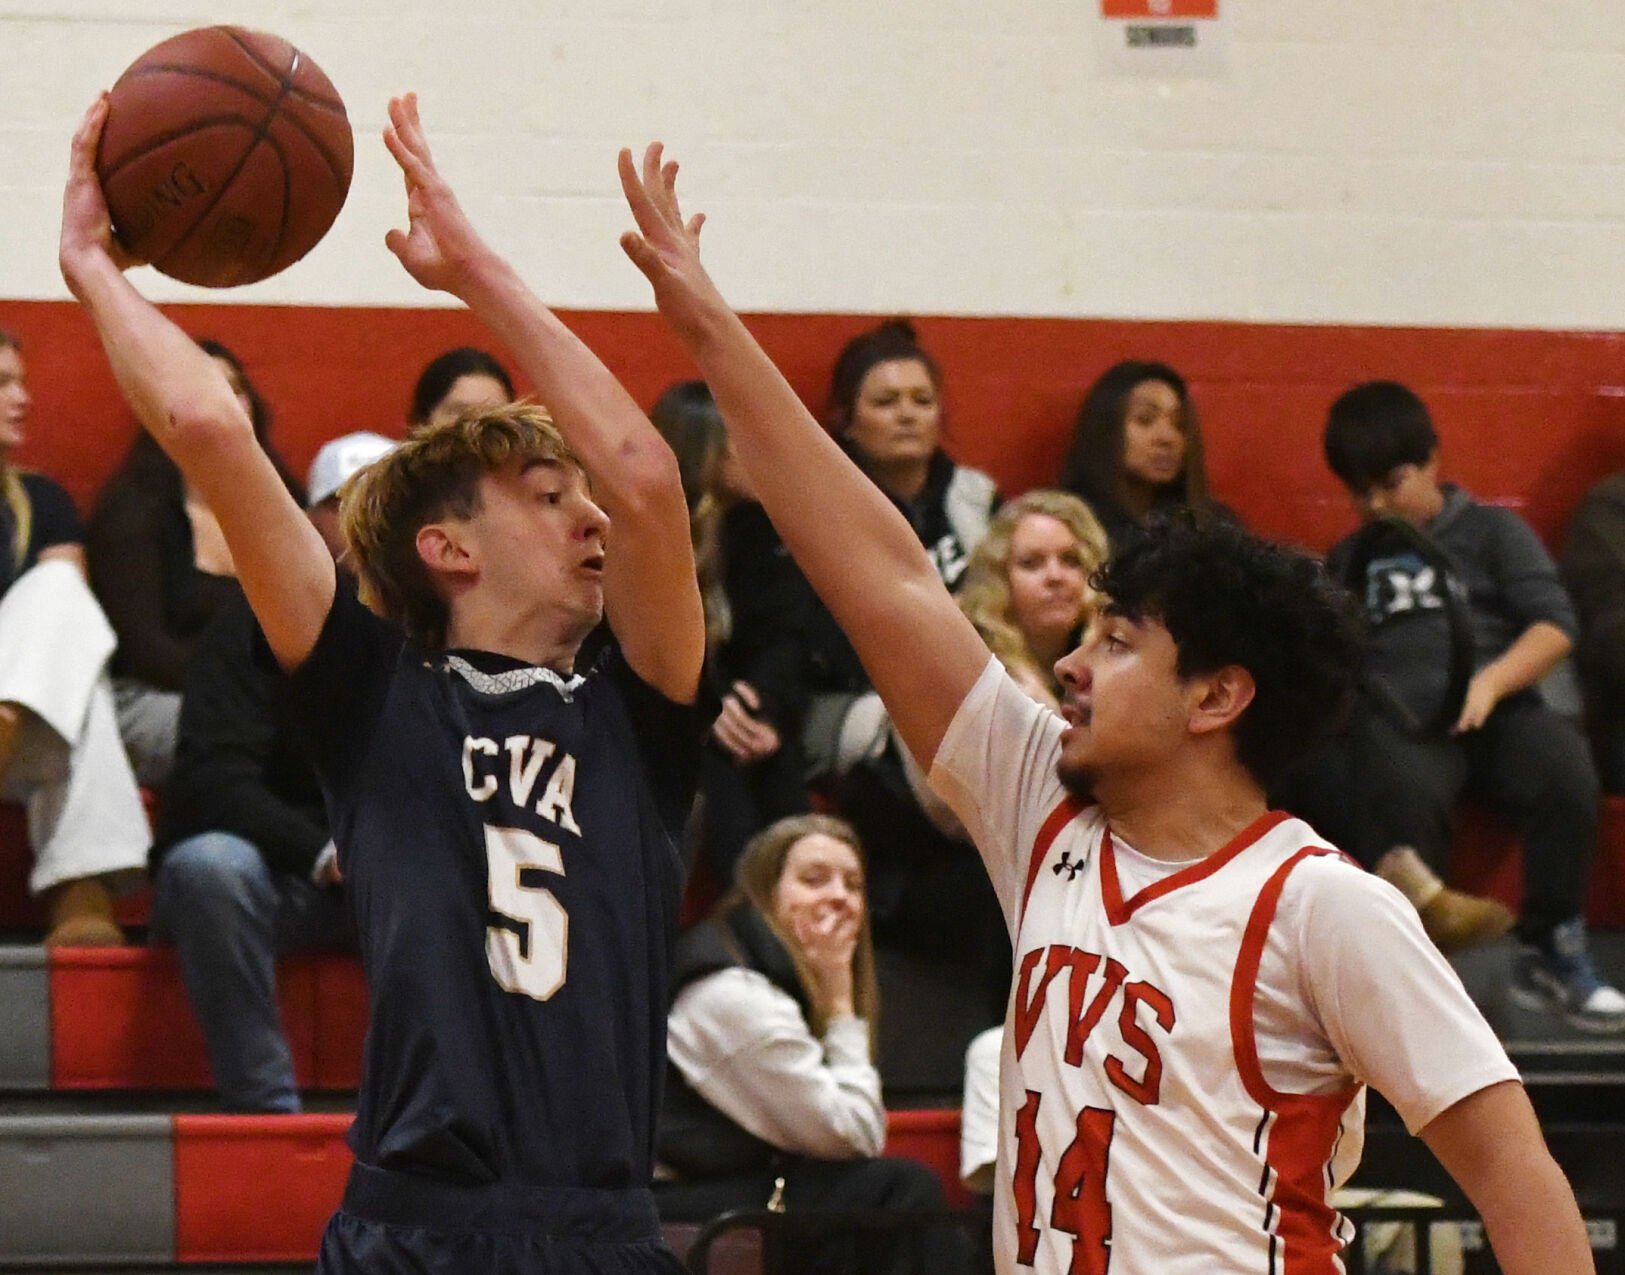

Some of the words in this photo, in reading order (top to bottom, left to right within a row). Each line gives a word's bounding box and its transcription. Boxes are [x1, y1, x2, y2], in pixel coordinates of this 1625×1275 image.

[461, 734, 583, 838] CVA
[483, 822, 570, 1003] 5
[1014, 943, 1176, 1106] VVS
[1012, 1088, 1117, 1275] 14
